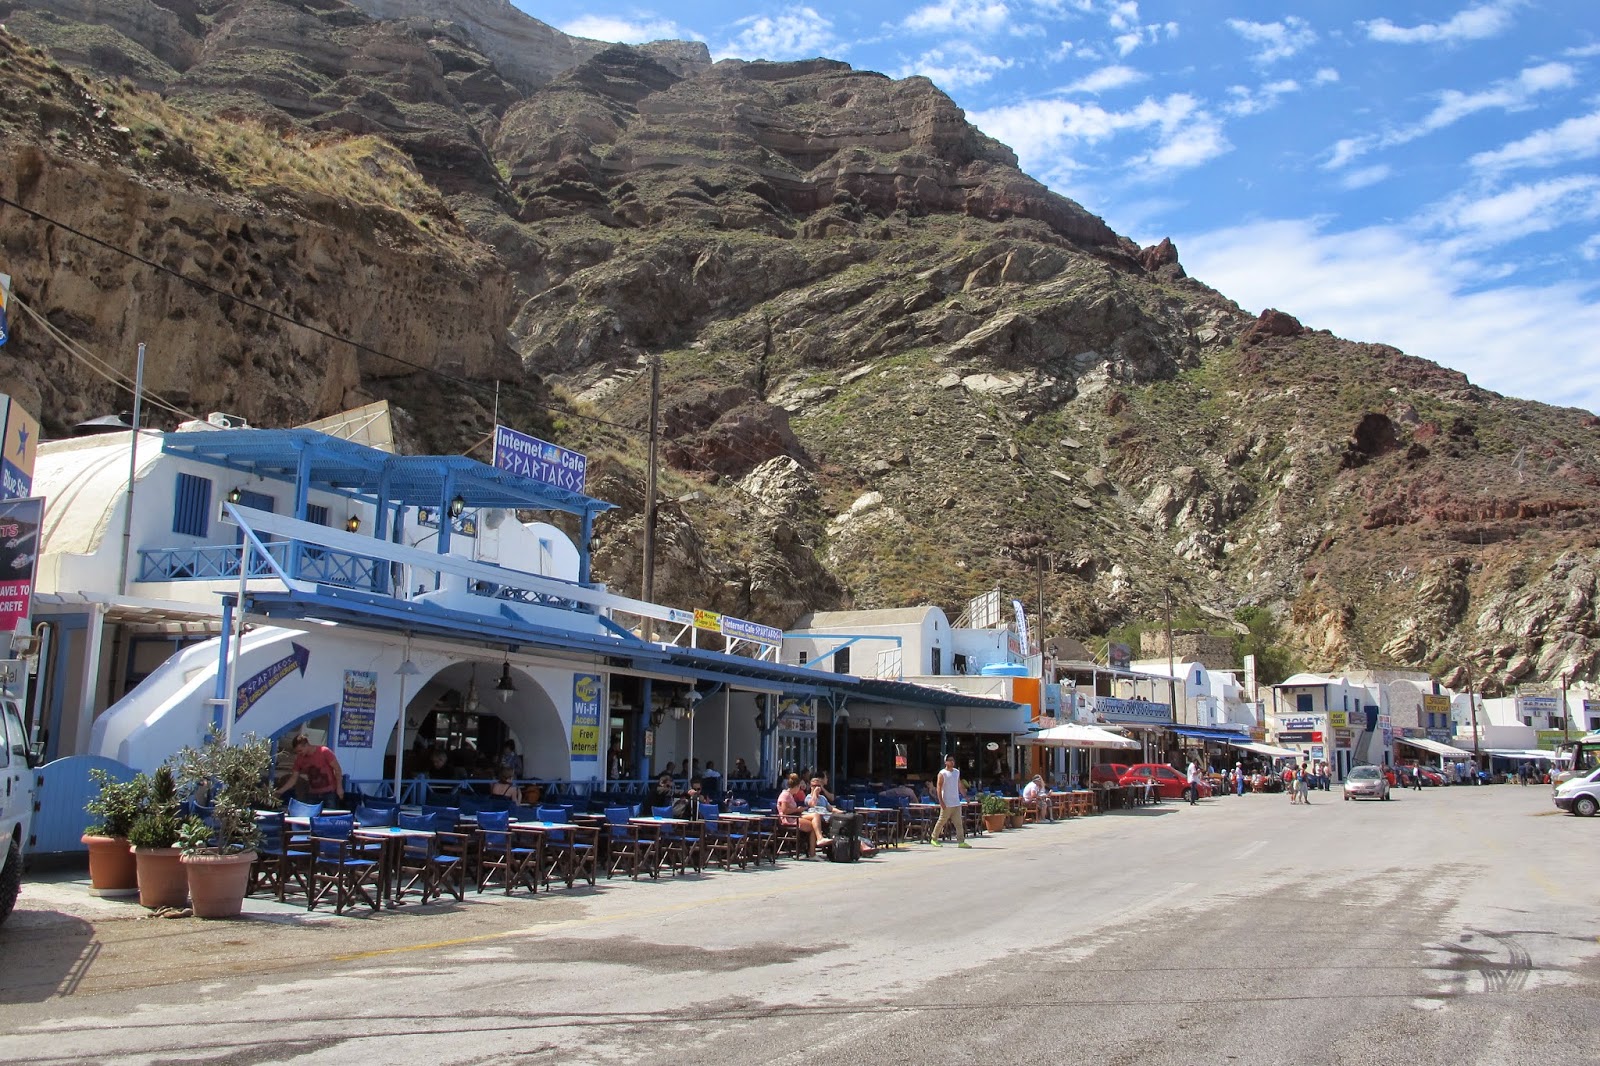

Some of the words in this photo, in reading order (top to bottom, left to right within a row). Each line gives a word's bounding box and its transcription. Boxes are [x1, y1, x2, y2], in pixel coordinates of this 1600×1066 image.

[498, 429, 543, 458] Internet
[562, 451, 584, 473] Cafe
[504, 451, 583, 492] SPARTAKOS
[3, 468, 17, 493] Blue
[16, 478, 28, 498] Star
[20, 584, 30, 596] TO
[0, 601, 23, 612] CRETE
[694, 609, 704, 619] 24
[725, 619, 744, 631] Internet
[745, 623, 755, 634] Cafe
[248, 657, 292, 694] SPARTAKOS
[575, 702, 597, 715] Wi-Fi
[575, 715, 597, 725] Access
[579, 729, 593, 739] Free
[571, 743, 597, 752] Internet
